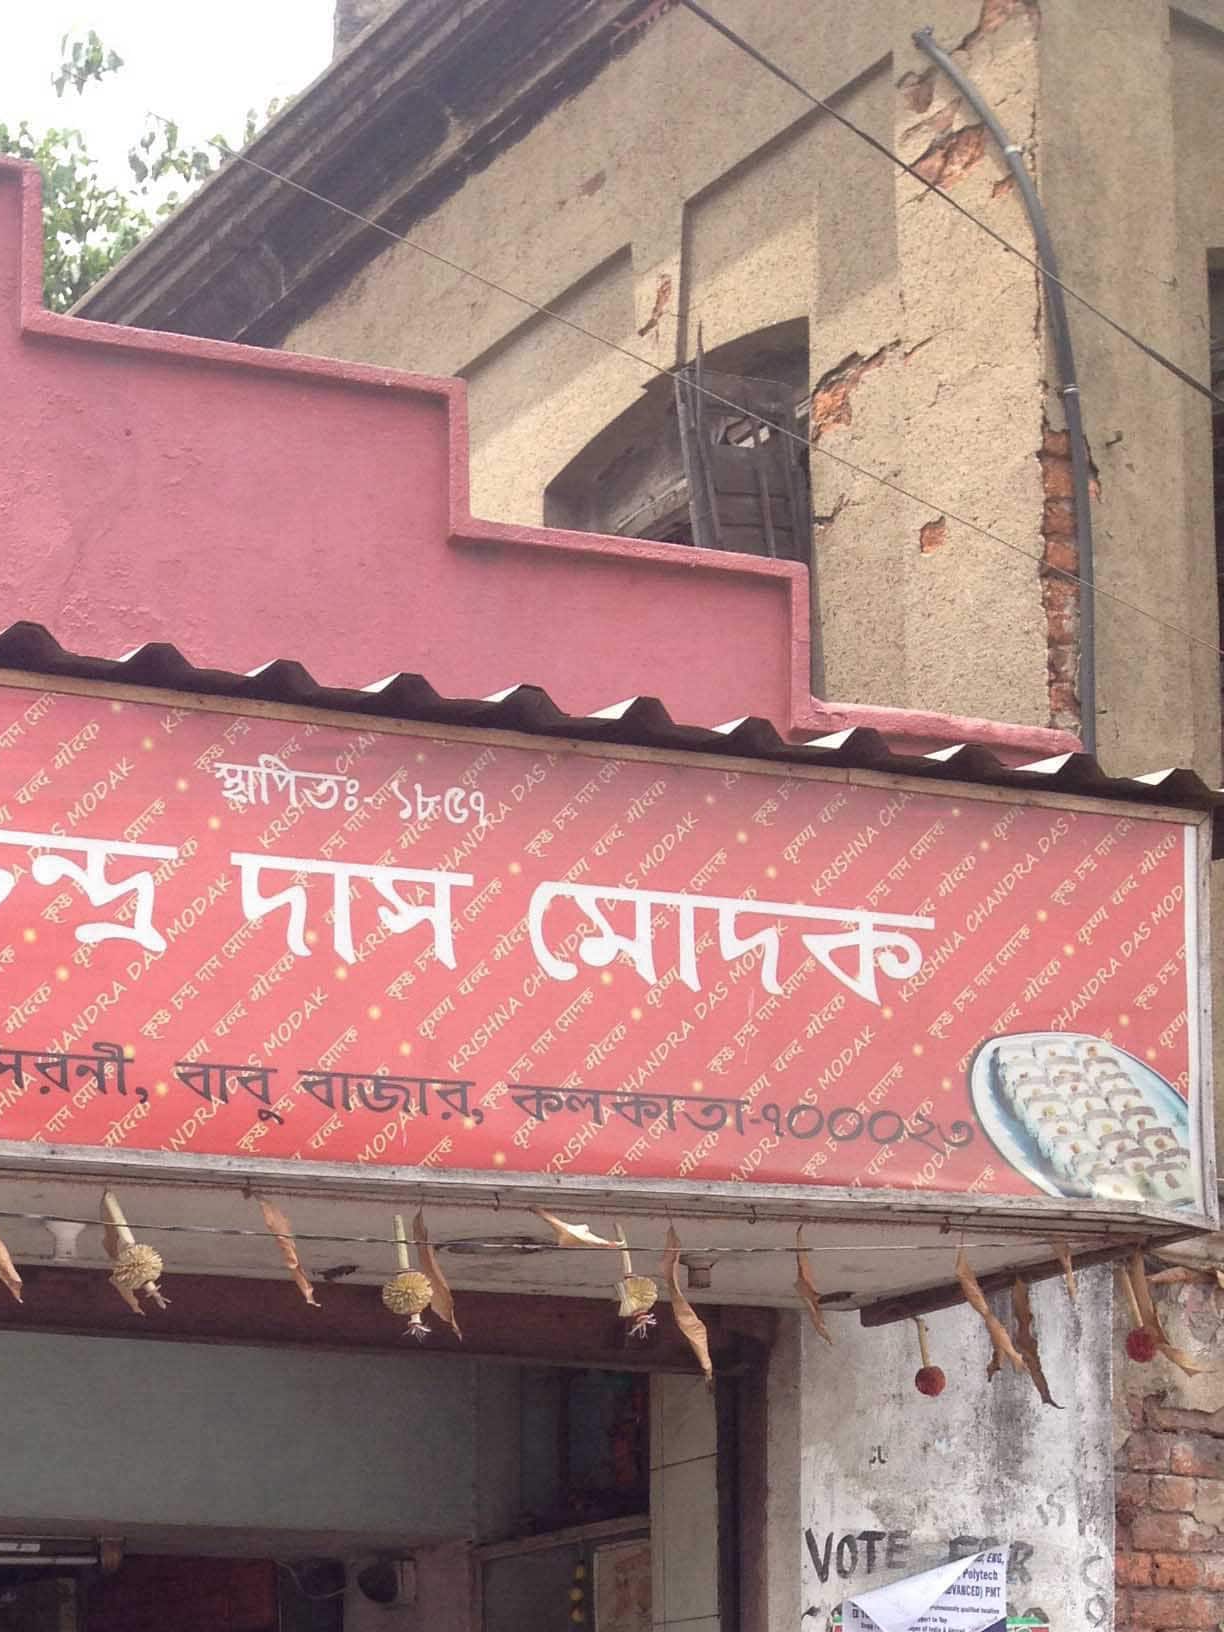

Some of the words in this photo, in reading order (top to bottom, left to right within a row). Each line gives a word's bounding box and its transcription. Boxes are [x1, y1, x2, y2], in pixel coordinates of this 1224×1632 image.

[66, 757, 135, 828] MODAK
[639, 812, 699, 876] MODAK
[810, 825, 879, 897] KRISHNA
[165, 874, 232, 943] MODAK
[230, 852, 474, 971] দাস
[528, 881, 936, 1006] মোদক
[898, 930, 966, 1003] KRISHNA
[965, 852, 1039, 933] CHANDRA
[1037, 818, 1069, 853] DAS
[693, 984, 729, 1020] DAS
[1051, 957, 1122, 1031] CHANDRA
[1120, 926, 1151, 958] DAS
[264, 986, 328, 1057] MODAK
[447, 998, 524, 1074] KRISHNA
[817, 1026, 876, 1090] MODAK
[174, 1061, 279, 1126] বাবু
[297, 1070, 484, 1124] বাজার,
[805, 1528, 911, 1583] VOTE
[964, 1568, 998, 1581] Polytech
